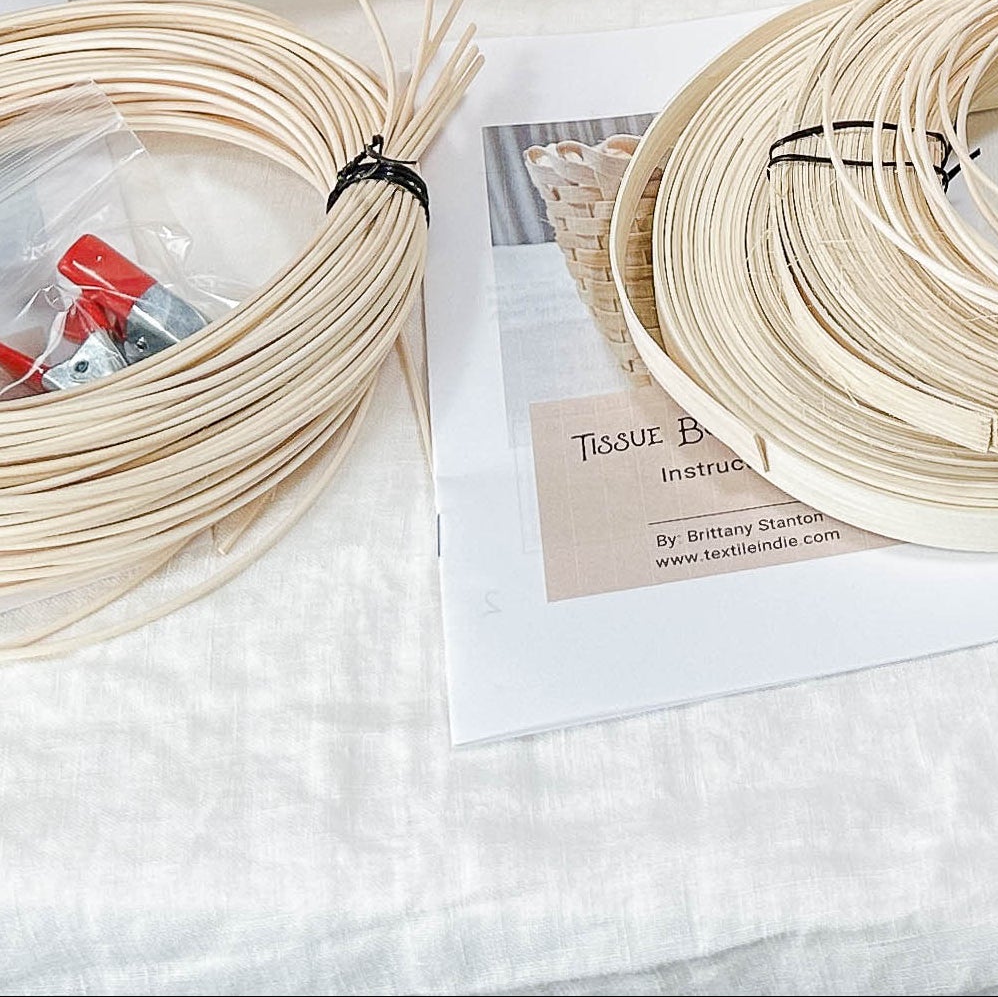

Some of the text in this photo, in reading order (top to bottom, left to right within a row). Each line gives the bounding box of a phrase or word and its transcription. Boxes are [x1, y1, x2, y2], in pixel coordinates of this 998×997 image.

[571, 416, 712, 461] TISSUE B
[662, 458, 751, 483] Instruc
[687, 523, 753, 543] Brittany
[758, 512, 824, 532] Stanton
[655, 529, 841, 568] www.textileindie.com
